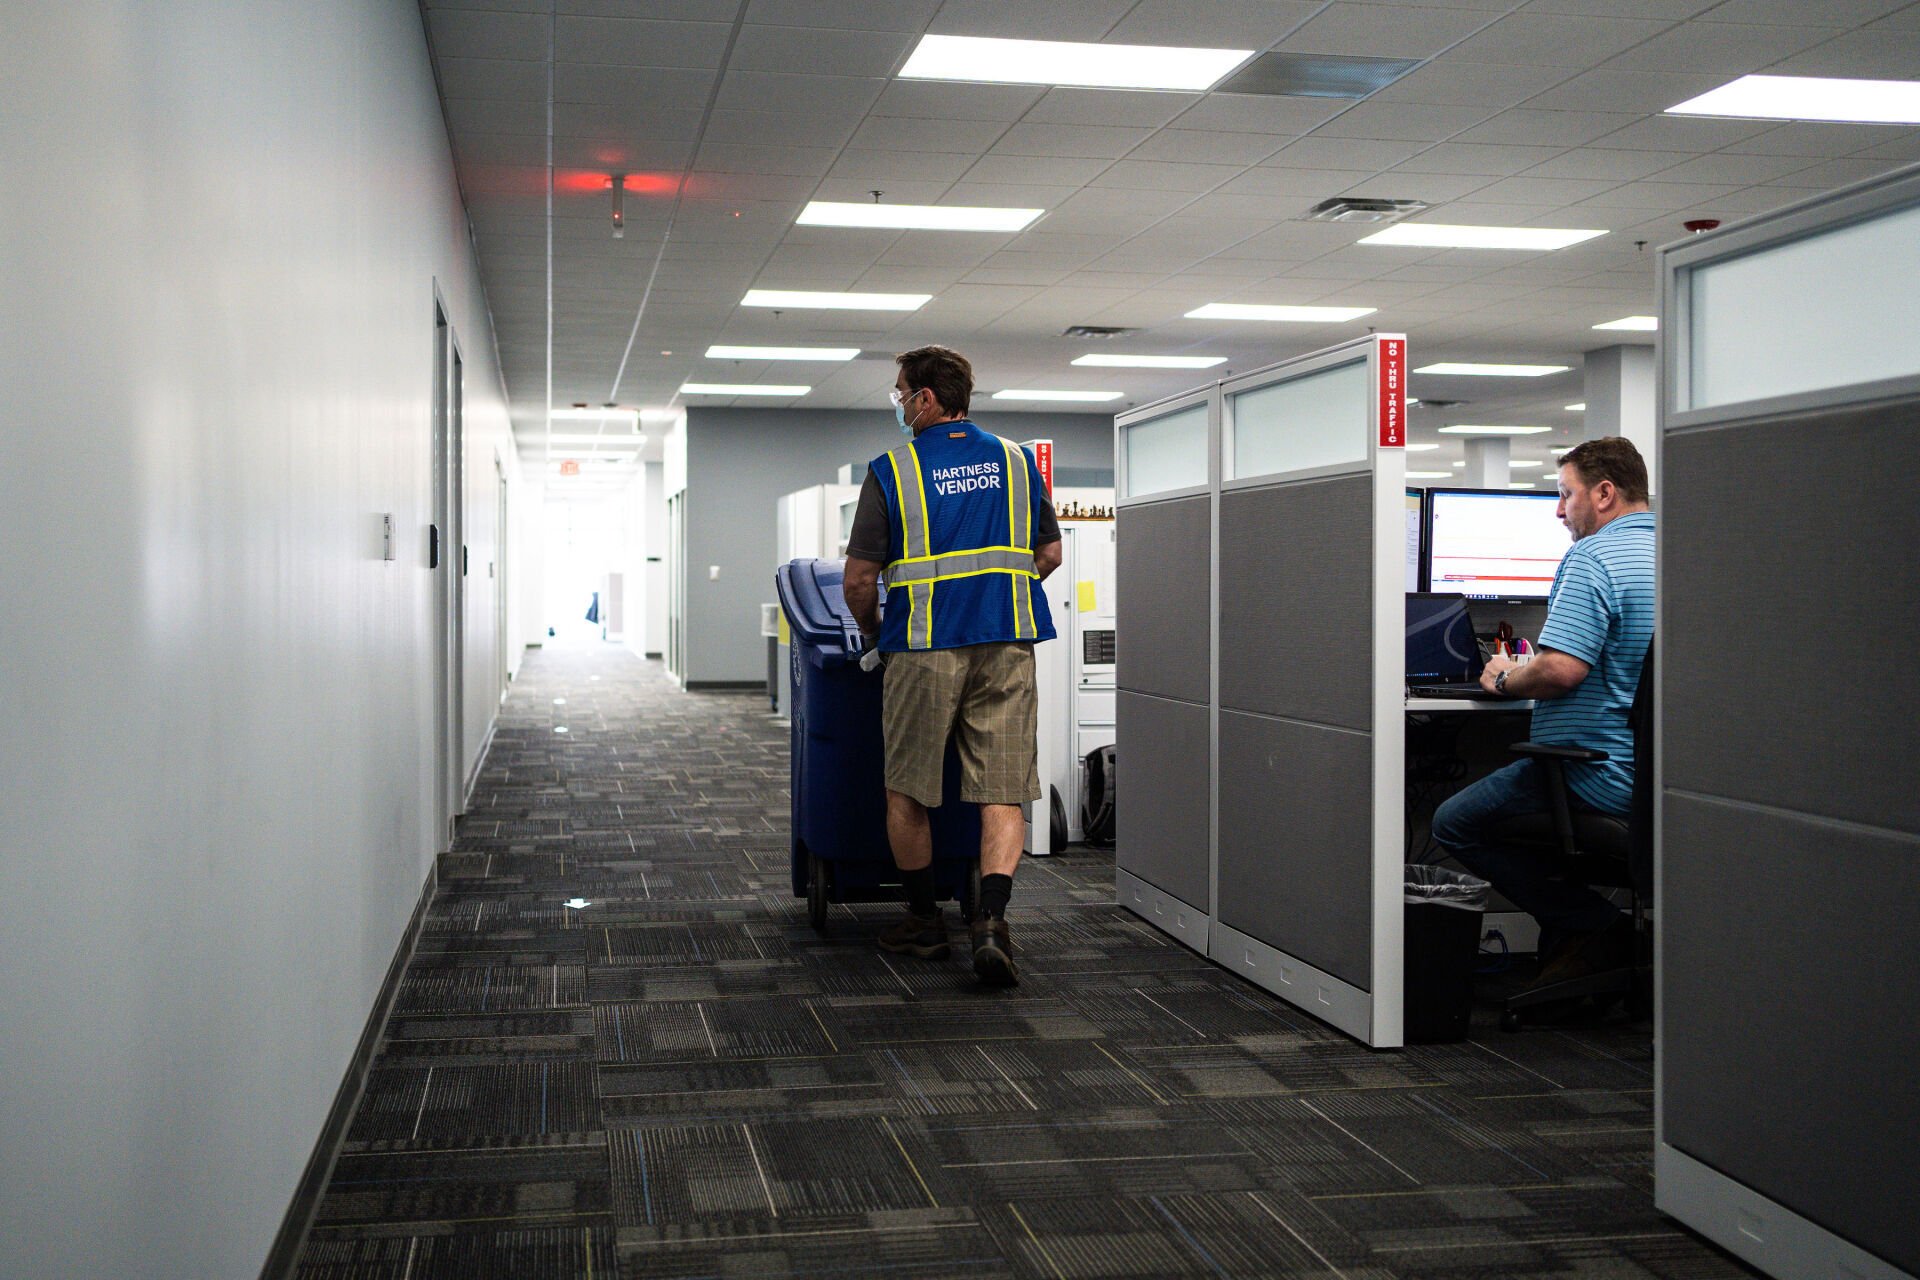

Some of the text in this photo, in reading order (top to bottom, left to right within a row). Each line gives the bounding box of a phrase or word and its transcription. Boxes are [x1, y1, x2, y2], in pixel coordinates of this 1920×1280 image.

[1388, 342, 1398, 443] NO THRU TRAFFIC
[932, 462, 1000, 481] HARTNESS
[935, 475, 1001, 496] VENDOR
